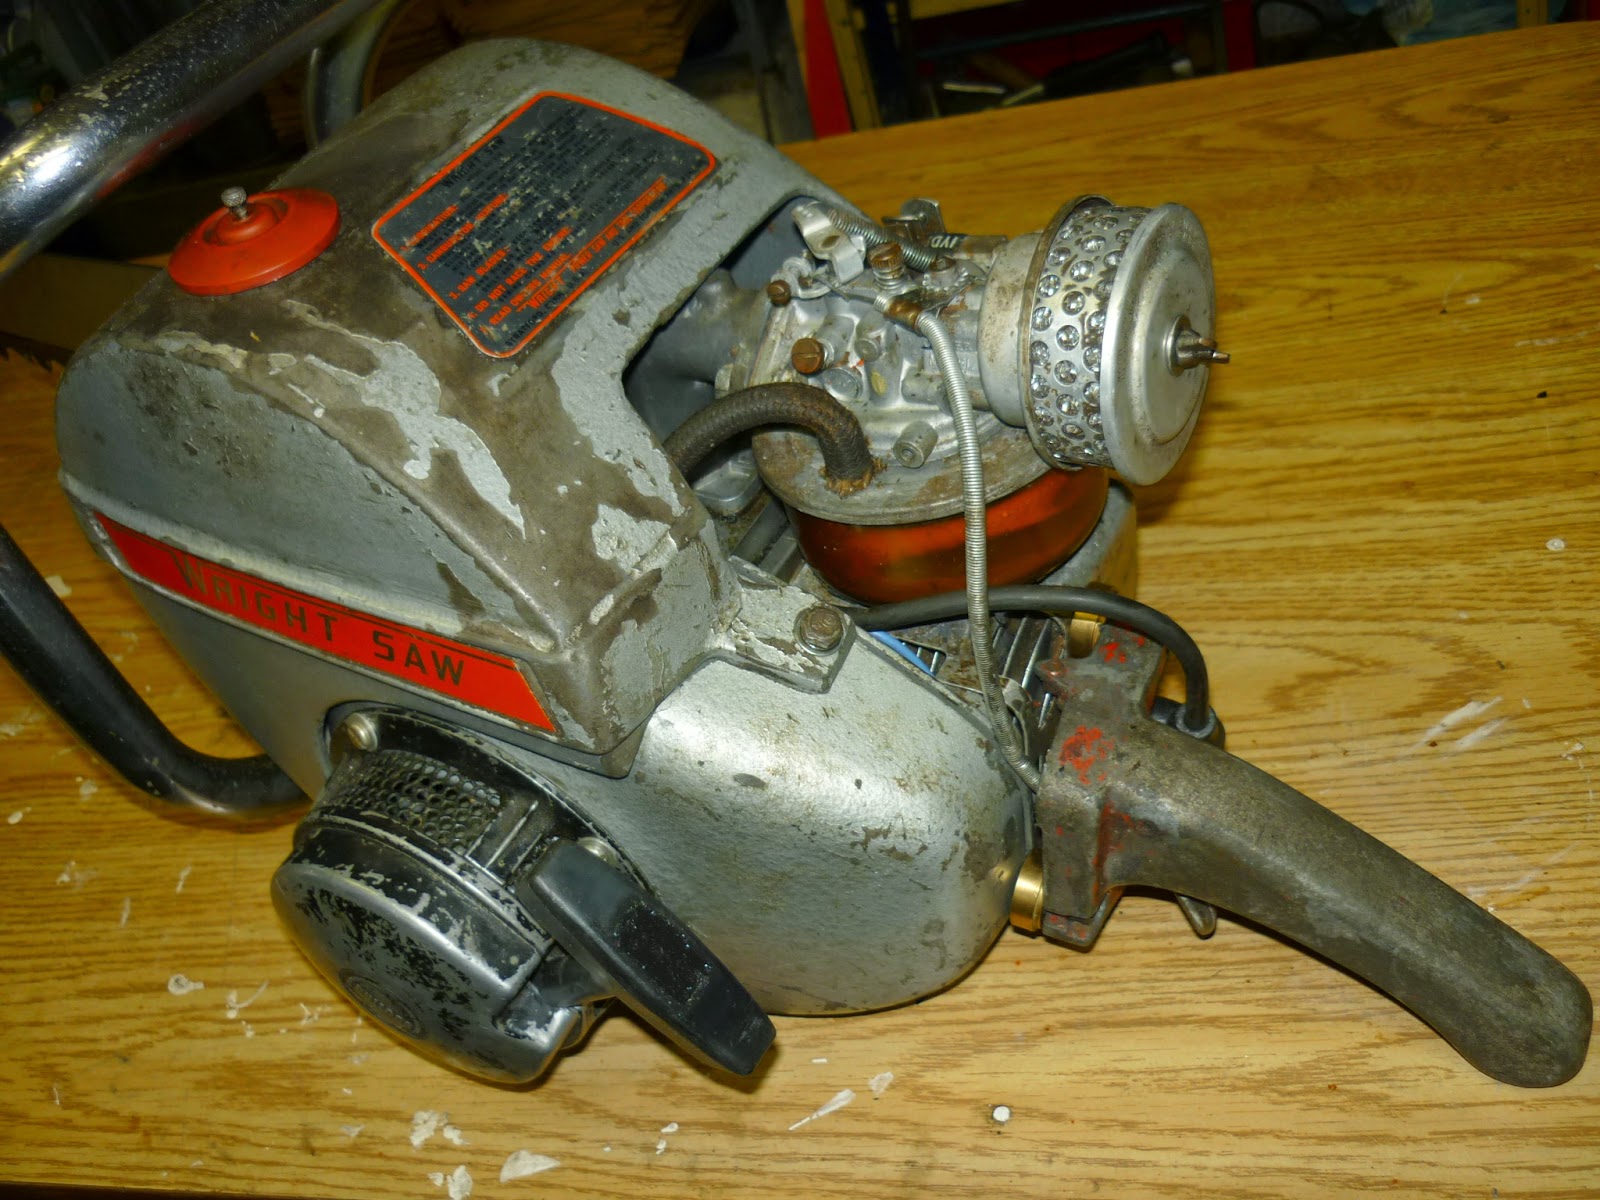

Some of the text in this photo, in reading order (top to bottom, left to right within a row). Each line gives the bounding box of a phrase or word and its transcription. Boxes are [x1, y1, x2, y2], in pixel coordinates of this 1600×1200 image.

[566, 249, 595, 273] POWER
[587, 236, 609, 253] SAW
[600, 224, 622, 241] AND
[456, 274, 477, 293] SAW
[473, 297, 490, 313] DO
[487, 283, 507, 301] NOT
[503, 265, 528, 286] RACE
[524, 250, 544, 267] THE
[487, 303, 512, 326] READ
[172, 551, 465, 686] WRIGHT SAW
